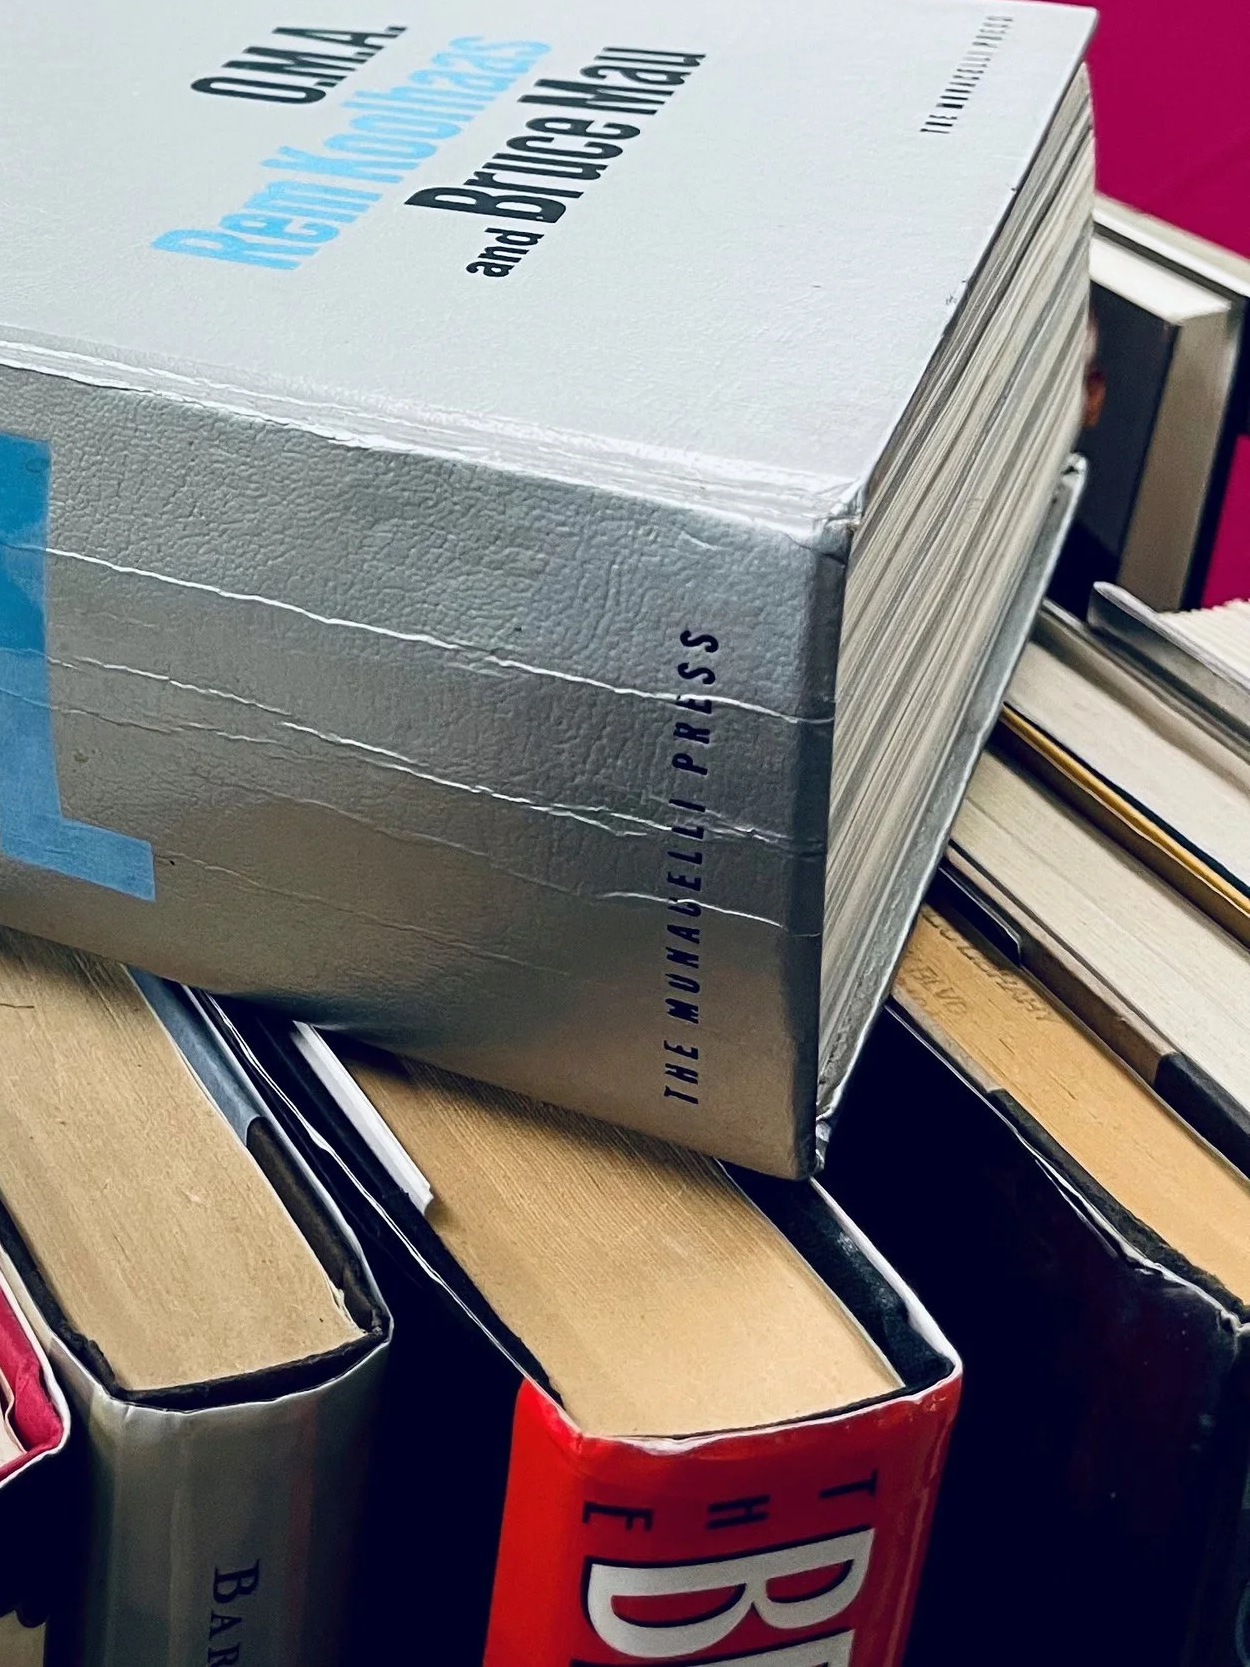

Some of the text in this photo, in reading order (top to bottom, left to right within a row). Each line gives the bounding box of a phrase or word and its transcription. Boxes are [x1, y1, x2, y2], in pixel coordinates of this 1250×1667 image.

[190, 26, 407, 105] O.M.A.
[151, 35, 551, 271] Rem Koolhaas
[404, 47, 706, 278] and Bruce Mau
[671, 629, 719, 776] PRESS
[663, 1039, 700, 1105] THE
